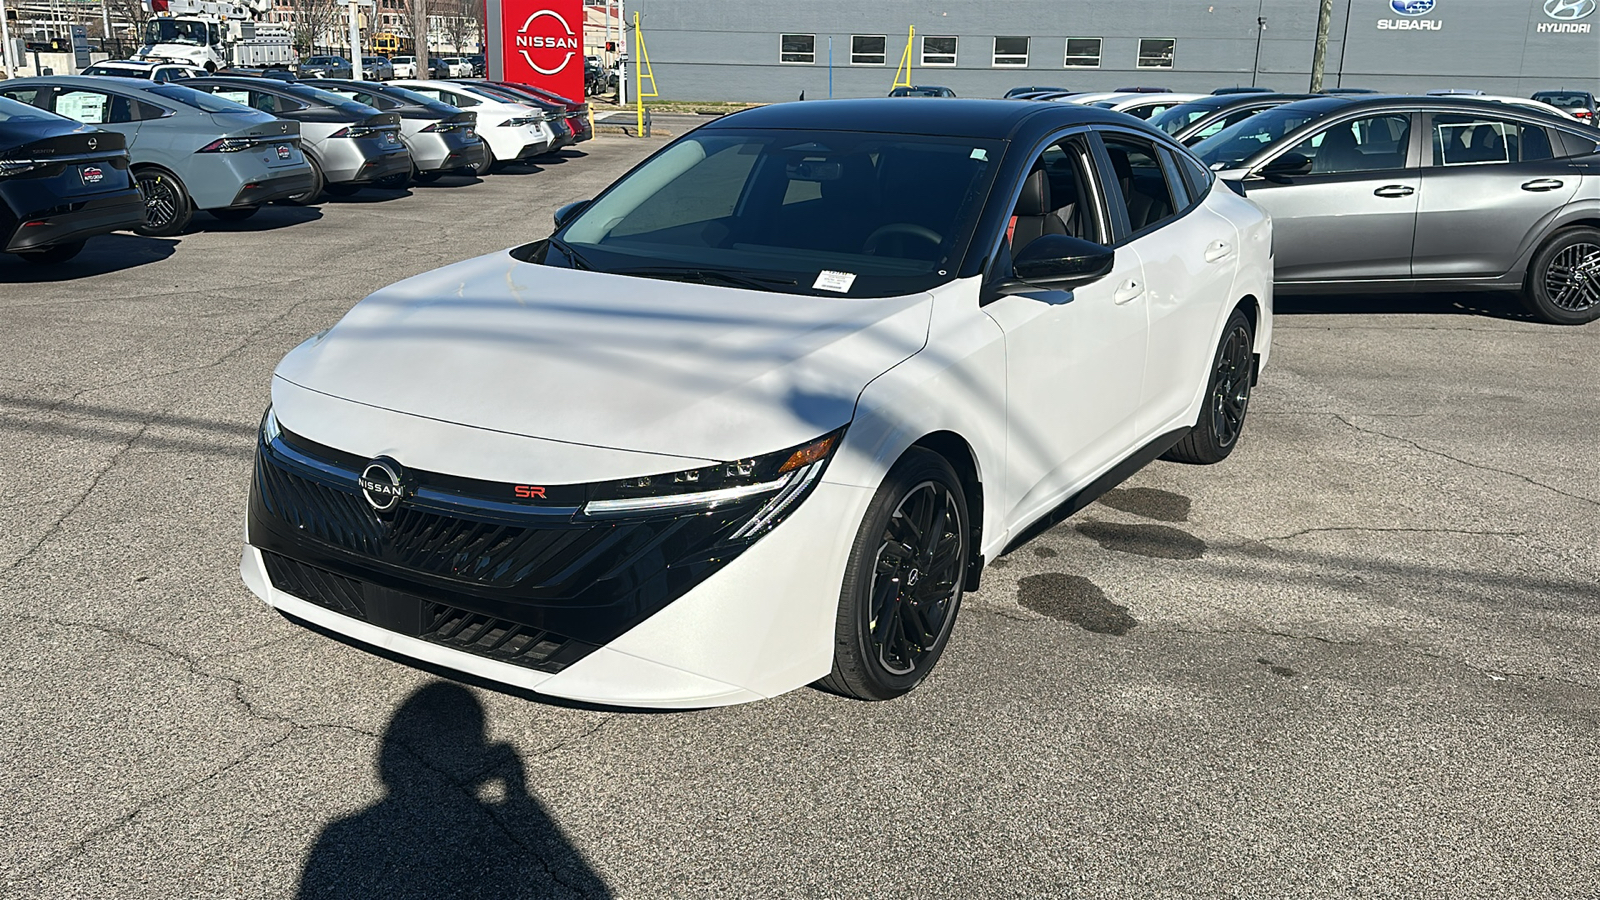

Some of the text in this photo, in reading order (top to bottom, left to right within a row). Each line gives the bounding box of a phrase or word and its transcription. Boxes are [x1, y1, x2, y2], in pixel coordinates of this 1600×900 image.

[1377, 19, 1442, 31] SUBARU
[1537, 23, 1591, 33] HYUNDAI
[516, 35, 578, 49] NISSAN
[358, 478, 401, 496] NISSAN
[514, 485, 547, 499] SR
